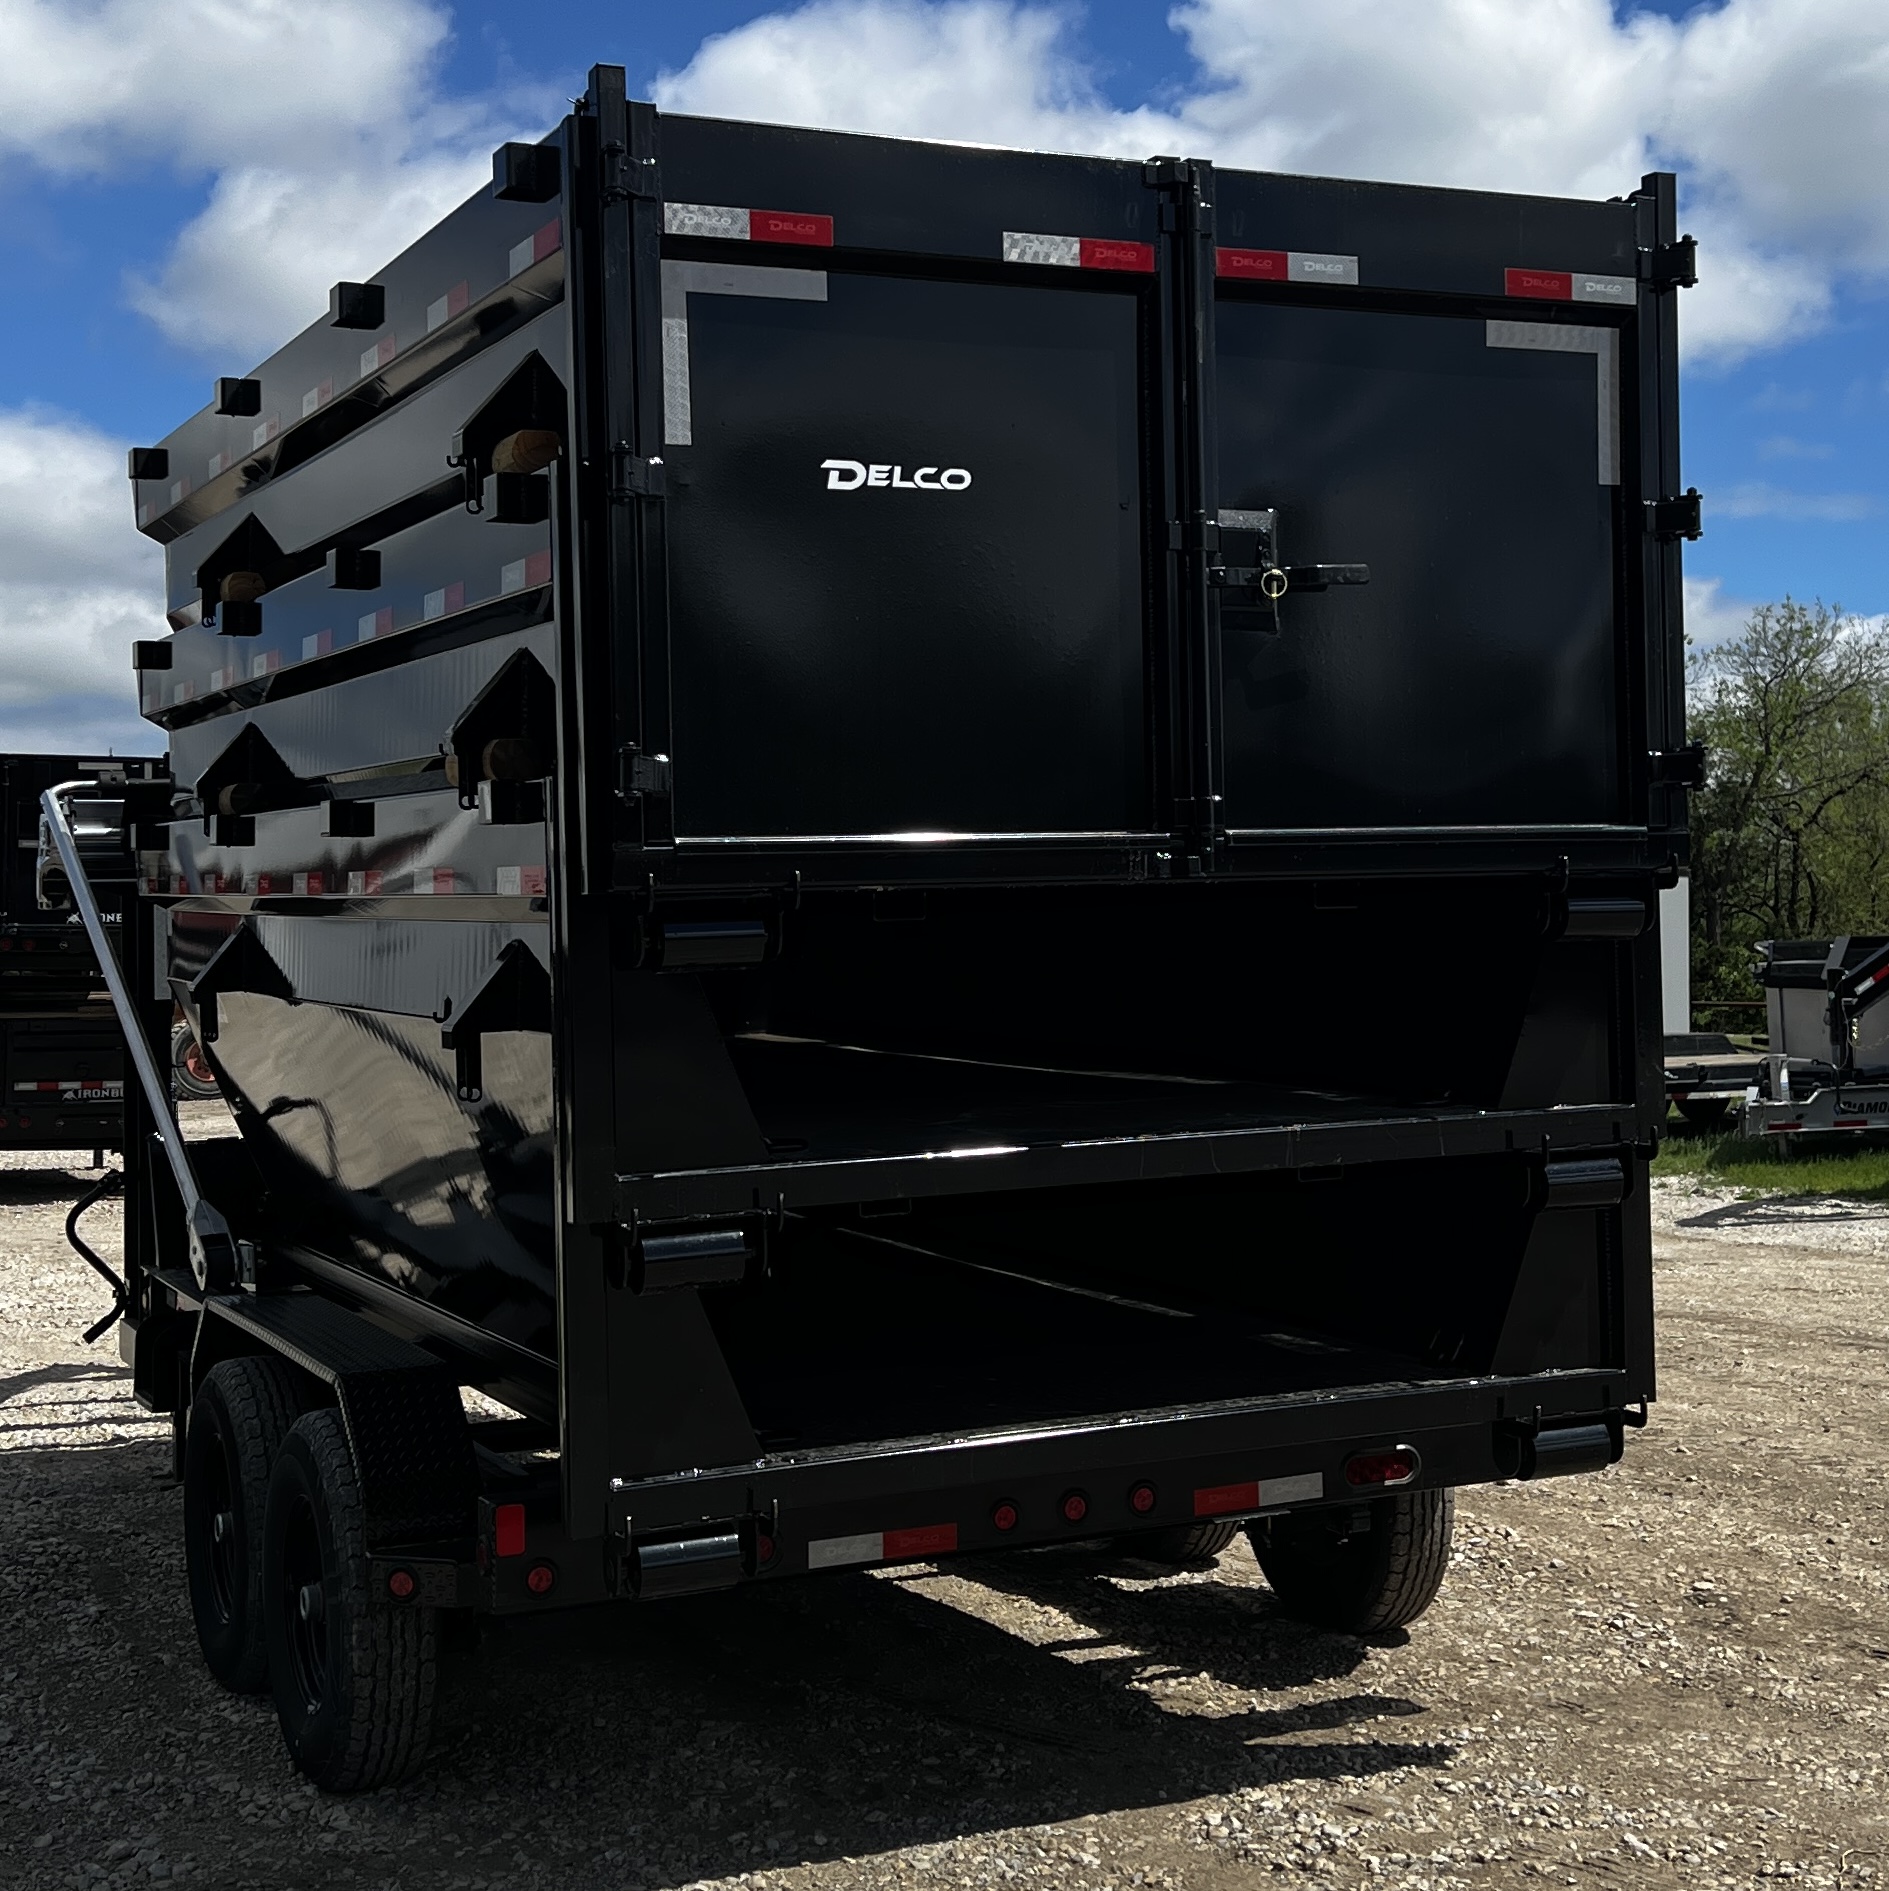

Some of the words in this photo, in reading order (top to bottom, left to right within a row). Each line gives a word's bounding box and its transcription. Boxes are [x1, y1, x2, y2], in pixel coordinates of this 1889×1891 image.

[768, 220, 816, 231] DELCO
[1095, 248, 1137, 259] DELCO
[1231, 256, 1273, 267] DELCO
[1303, 261, 1344, 272] DELCO
[1521, 276, 1560, 287] DELCO
[1585, 282, 1622, 292] DELCO
[820, 459, 972, 491] DELCO
[1840, 1101, 1889, 1114] DIAMO
